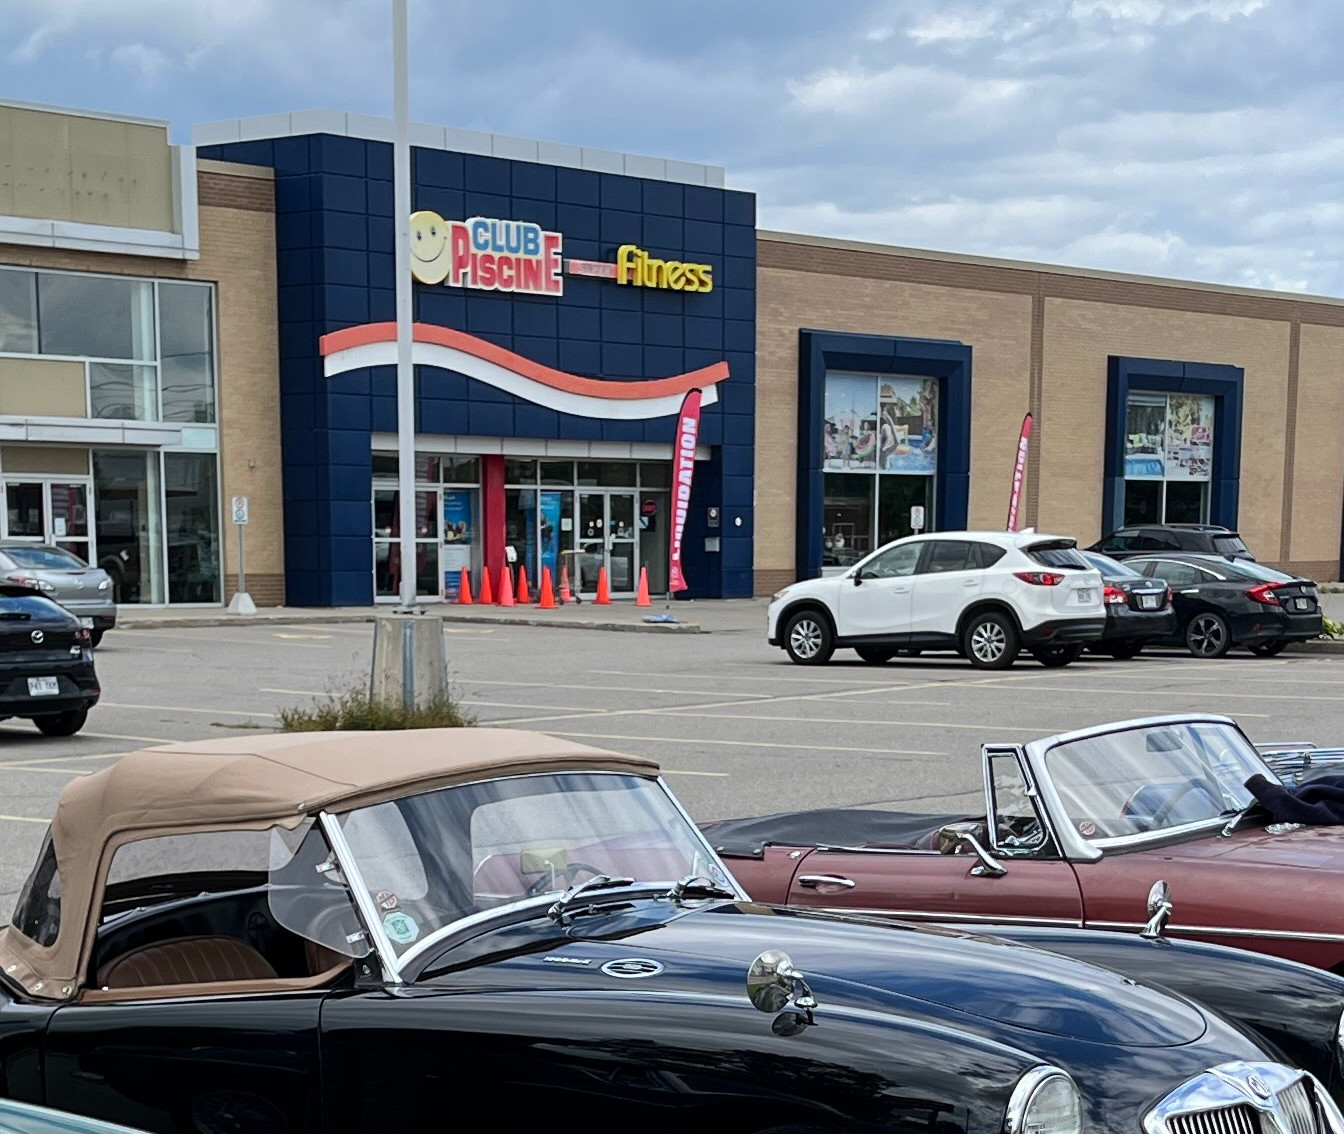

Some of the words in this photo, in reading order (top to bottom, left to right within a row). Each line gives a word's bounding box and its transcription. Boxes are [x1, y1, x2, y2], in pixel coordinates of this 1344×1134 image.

[451, 224, 561, 293] PISCINE
[471, 220, 541, 256] CLUB
[671, 416, 696, 561] LQUIDATION
